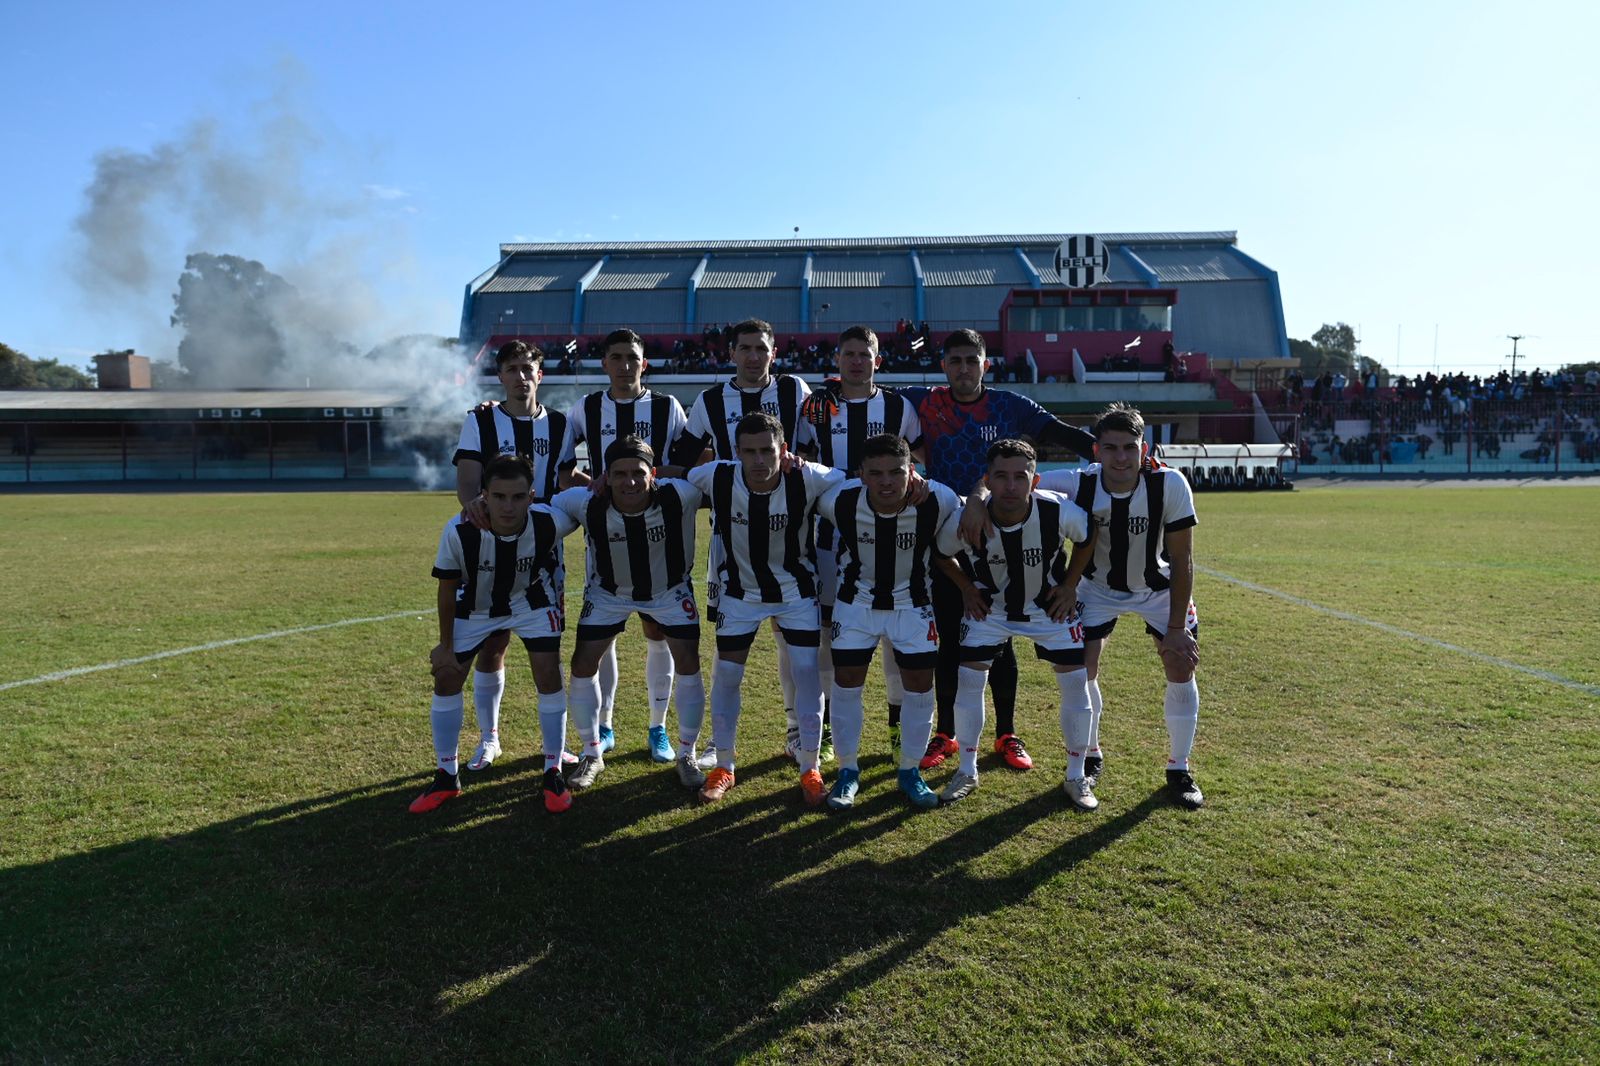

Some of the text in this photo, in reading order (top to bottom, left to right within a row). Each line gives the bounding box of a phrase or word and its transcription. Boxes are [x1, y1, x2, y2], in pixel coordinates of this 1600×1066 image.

[1062, 257, 1101, 267] BELL
[198, 408, 394, 418] 1904 CLUB
[681, 599, 696, 620] 9
[927, 620, 938, 645] 4
